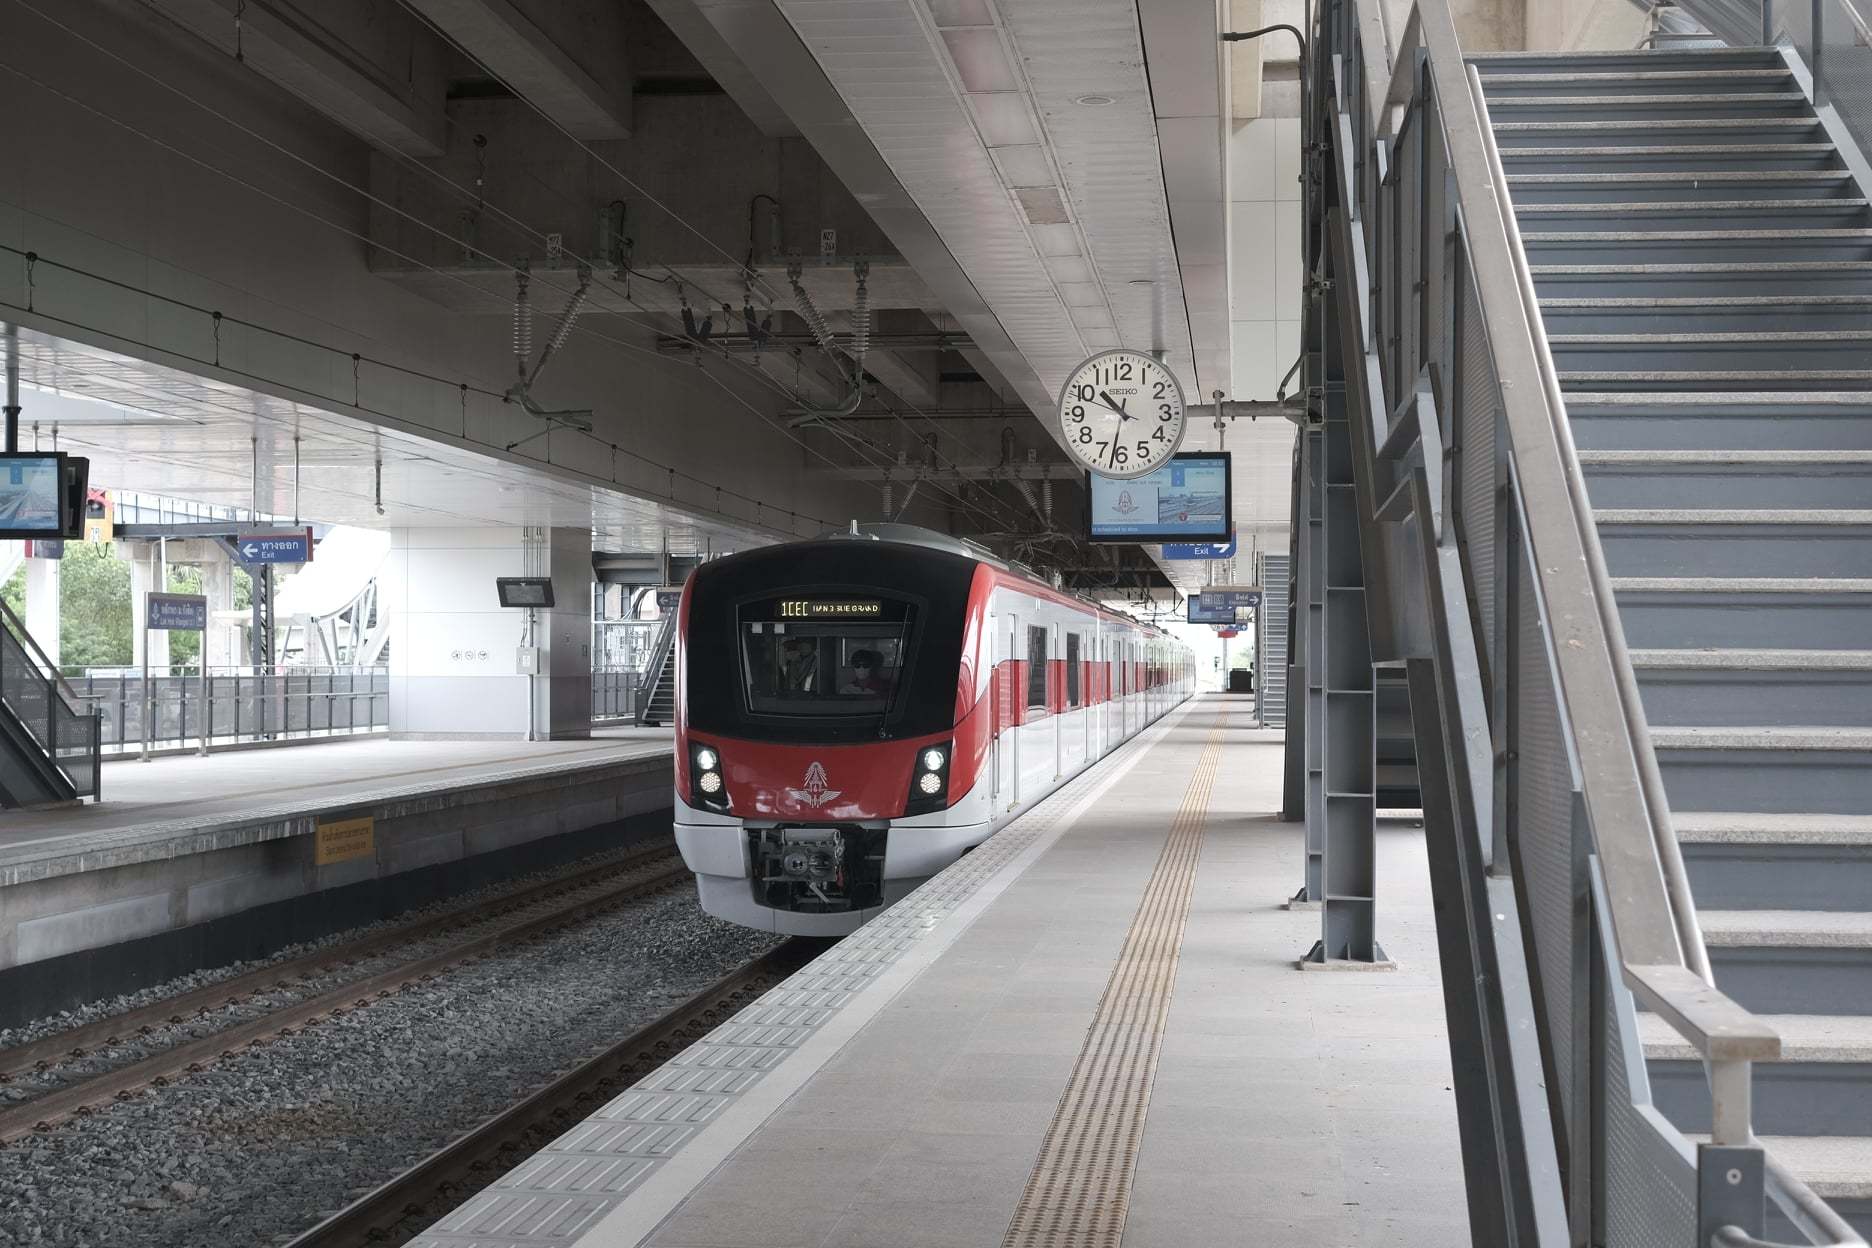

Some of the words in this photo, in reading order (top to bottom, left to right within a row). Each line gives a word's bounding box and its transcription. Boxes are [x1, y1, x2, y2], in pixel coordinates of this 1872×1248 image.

[1095, 367, 1109, 386] 11
[1114, 363, 1132, 380] 12
[1142, 367, 1146, 385] 1
[1077, 384, 1096, 403] 10
[1152, 381, 1166, 400] 2
[1071, 405, 1085, 424] 9
[1158, 403, 1173, 422] 3
[1079, 426, 1093, 445] 8
[1151, 425, 1166, 443] 4
[1095, 441, 1109, 459] 7
[1114, 445, 1129, 465] 6
[1136, 440, 1150, 459] 5
[261, 541, 299, 550] ทางออก
[1194, 547, 1209, 555] Exit
